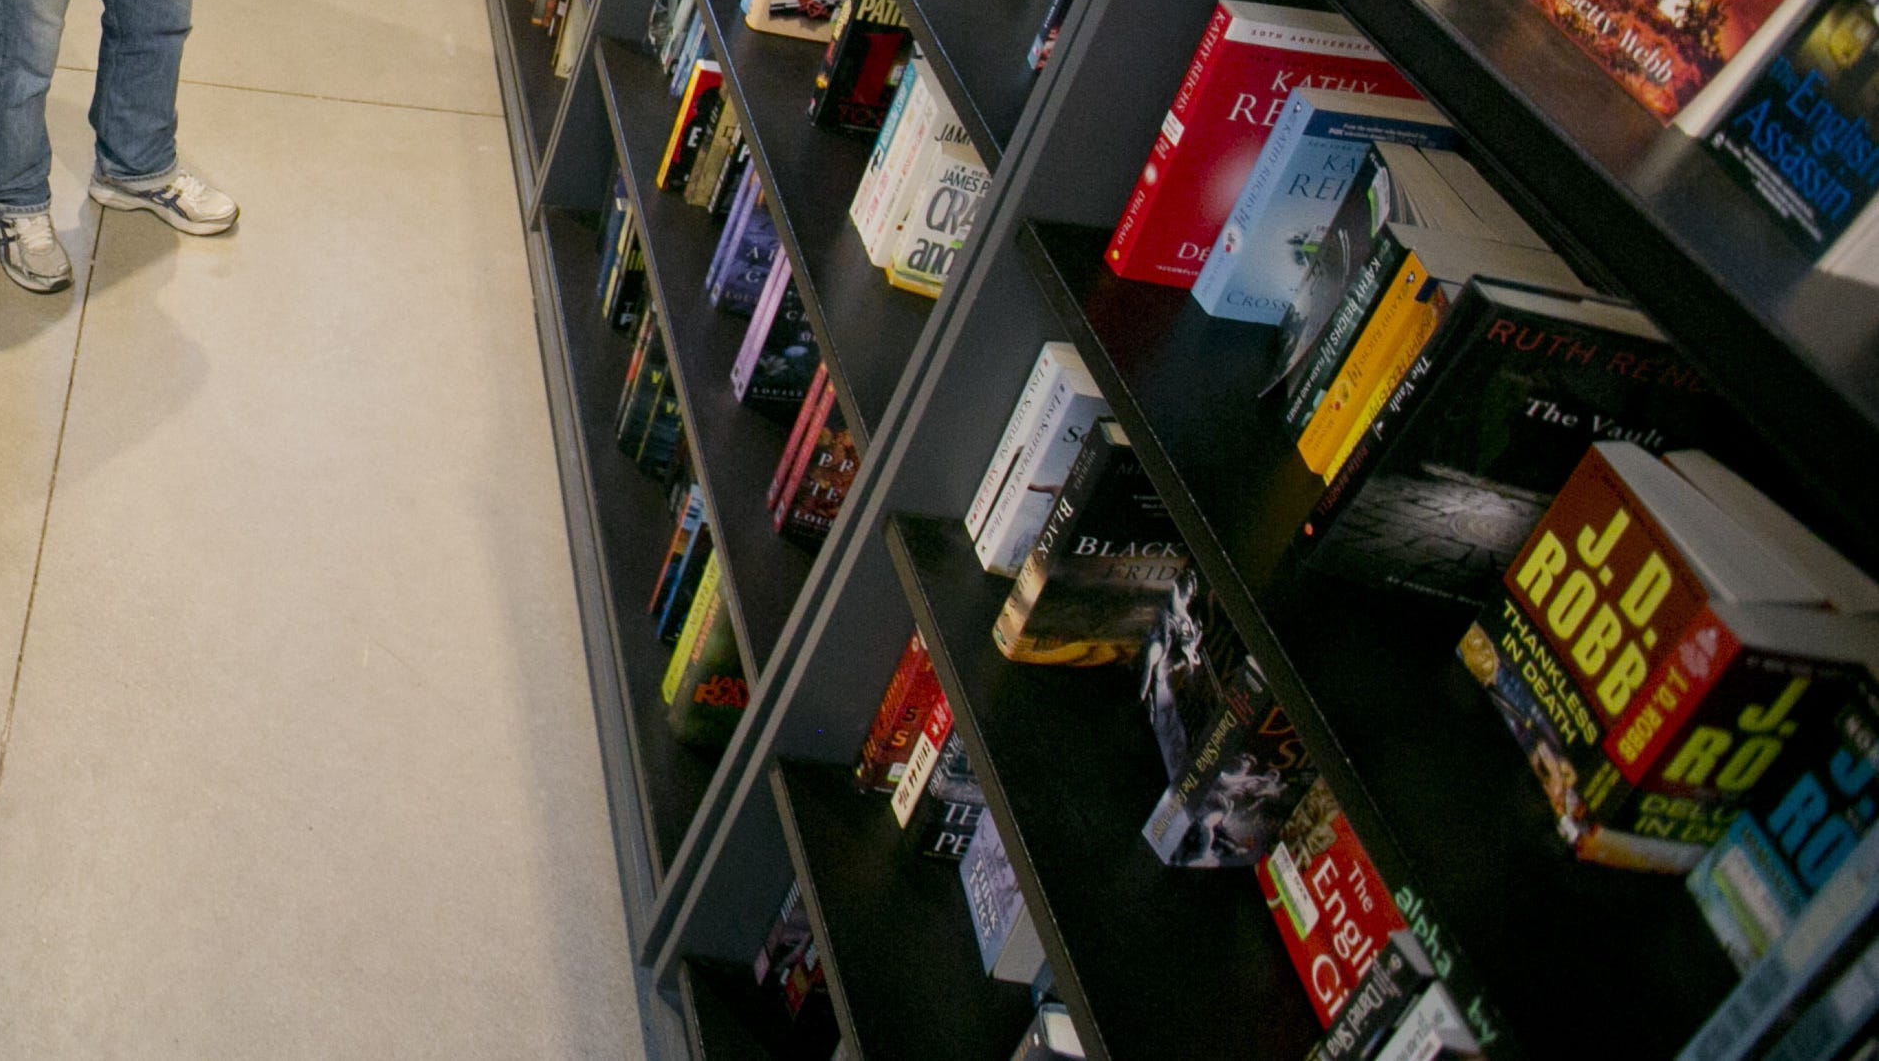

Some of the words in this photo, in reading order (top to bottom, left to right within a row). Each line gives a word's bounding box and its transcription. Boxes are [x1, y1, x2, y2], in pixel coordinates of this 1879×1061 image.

[1618, 22, 1678, 88] Webb
[1271, 69, 1381, 96] KATHY
[1731, 99, 1855, 222] Assassin
[1352, 251, 1379, 302] KATHY
[1330, 300, 1358, 349] REICHS
[1485, 318, 1600, 368] RUTH
[1411, 355, 1433, 386] The
[1384, 377, 1417, 419] Vault
[1524, 397, 1579, 429] The
[1586, 415, 1666, 449] Vault
[1036, 494, 1076, 565] BLACK
[1073, 534, 1185, 560] BLACK
[1575, 507, 1631, 587] J.
[1617, 551, 1674, 649] D.
[1514, 529, 1650, 718] ROBB
[1501, 599, 1603, 746] THANKLESS
[1519, 652, 1579, 746] DEATH
[1348, 860, 1376, 912] The
